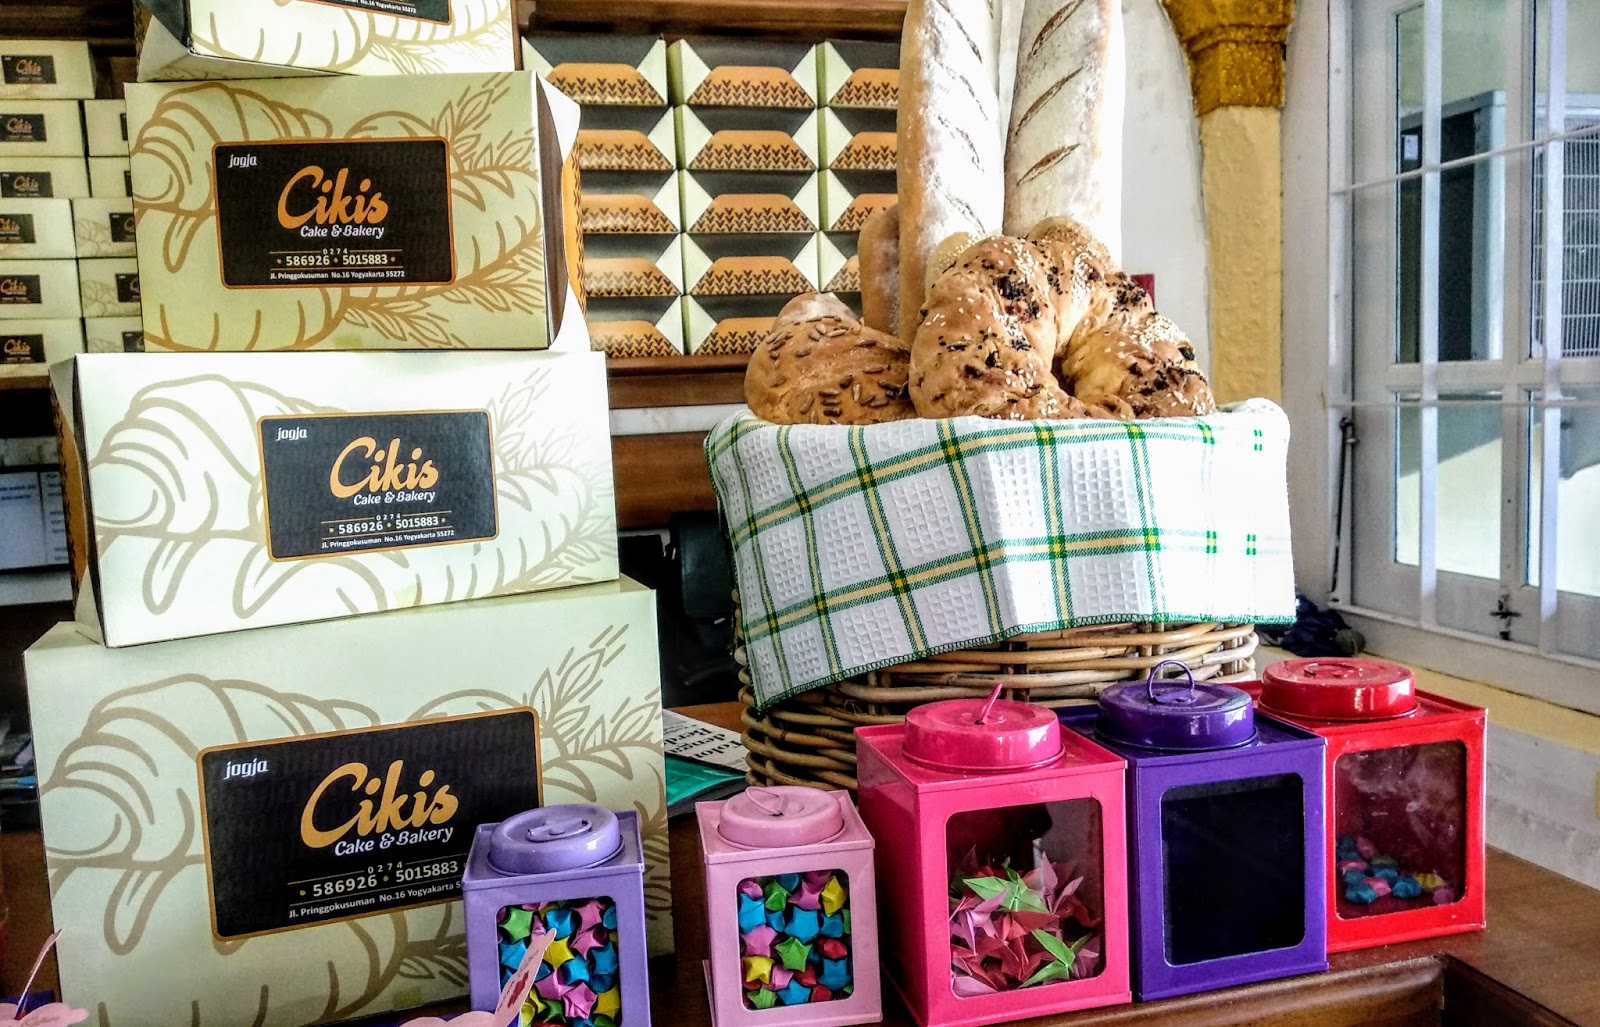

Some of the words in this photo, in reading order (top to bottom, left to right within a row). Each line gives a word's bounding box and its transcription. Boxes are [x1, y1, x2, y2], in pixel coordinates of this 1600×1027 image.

[375, 1, 401, 11] Yogyakarta
[402, 5, 417, 14] 55272
[228, 154, 258, 168] jogja
[277, 165, 389, 229] Cikis
[300, 225, 328, 238] Cake
[285, 255, 330, 266] 586926
[342, 253, 388, 265] 5015883
[278, 271, 329, 281] Pringgokusuman
[350, 271, 385, 280] Yogyakarta
[385, 270, 405, 278] 55272
[276, 426, 308, 442] jogja
[330, 436, 439, 499] Cikis
[353, 493, 381, 506] Cake
[338, 520, 383, 535] 586926
[395, 515, 439, 529] 5015883
[321, 541, 329, 549] Jl.
[330, 538, 382, 548] Pringgokusuman
[384, 534, 403, 543] No.16
[403, 532, 436, 541] Yogyakarta
[436, 530, 455, 538] 55272
[223, 757, 269, 780] jogja
[300, 759, 459, 848] Cikis
[334, 838, 375, 856] Cake
[313, 874, 378, 897] 586926
[395, 860, 459, 883] 5015883
[288, 909, 299, 919] Jl.
[300, 897, 376, 916] Pringgokusuman
[379, 891, 406, 903] No.16
[407, 883, 454, 897] Yogyakarta
